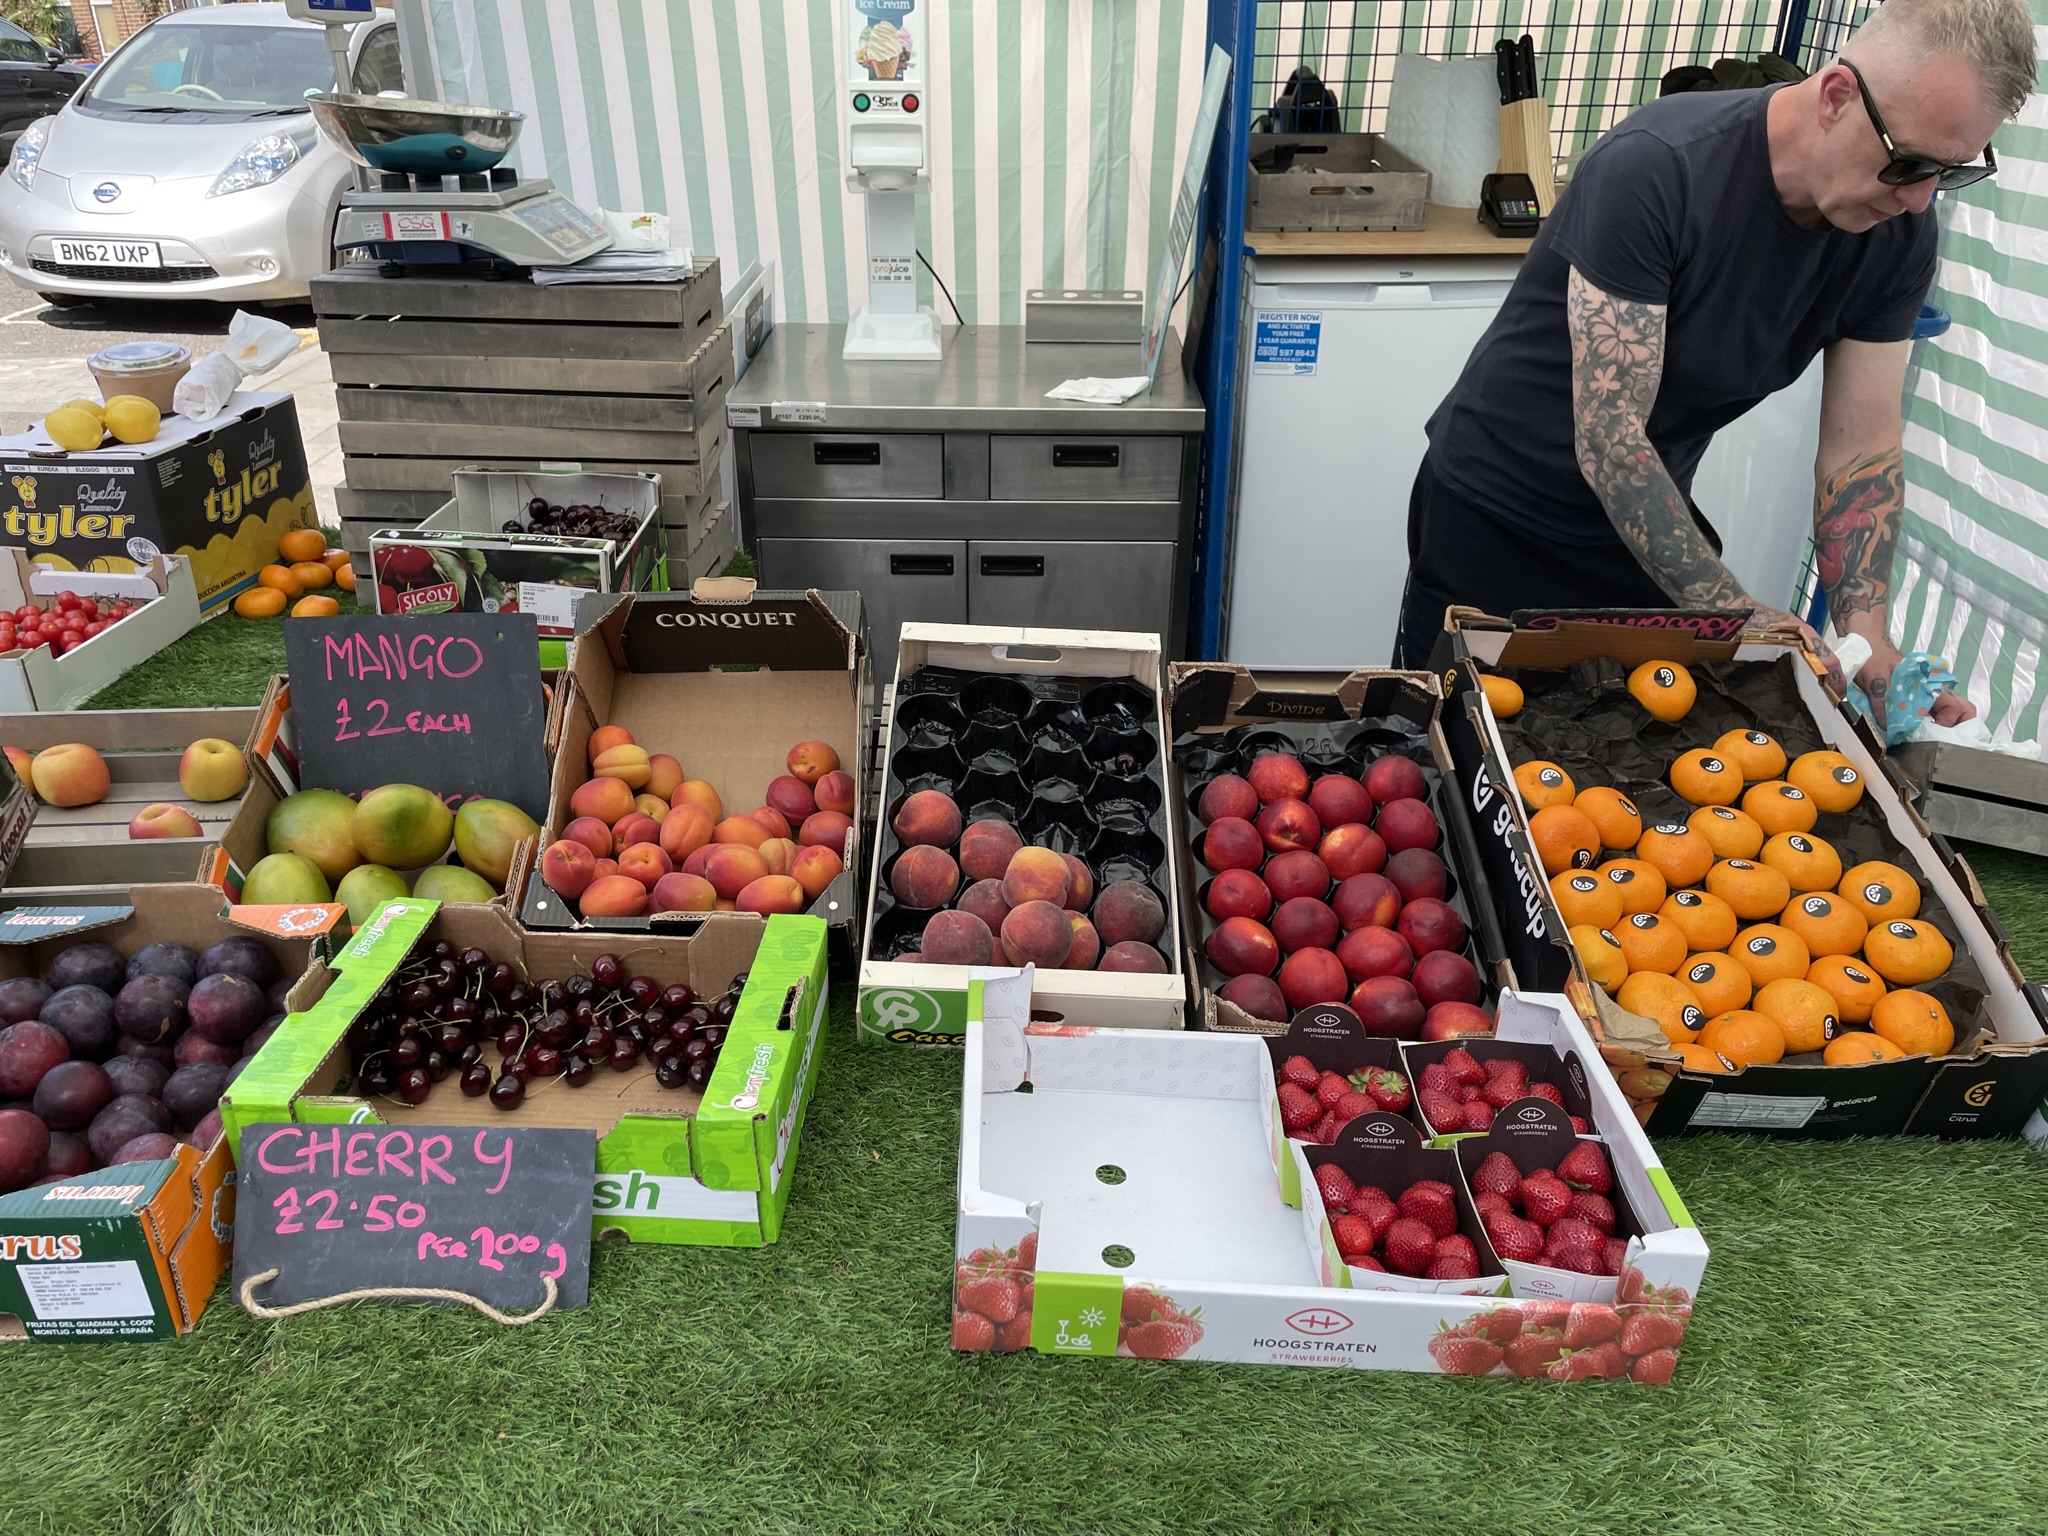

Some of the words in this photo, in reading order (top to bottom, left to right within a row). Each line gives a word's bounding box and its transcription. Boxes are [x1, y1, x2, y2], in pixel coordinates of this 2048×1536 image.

[876, 0, 911, 9] Cream
[877, 99, 899, 107] Shot
[398, 217, 434, 229] CSG
[60, 243, 110, 261] BN62
[113, 245, 149, 262] UXP
[874, 263, 909, 274] projuice
[1260, 313, 1299, 321] REGISTER
[1279, 349, 1294, 357] 597
[248, 427, 276, 462] Quality
[77, 477, 127, 512] Quality
[203, 460, 283, 524] tyler
[3, 504, 136, 546] tyler
[220, 570, 247, 589] ARGENTINA
[403, 586, 453, 611] SICOLY
[655, 612, 796, 629] CONQUET
[325, 632, 484, 682] MANGO
[1266, 700, 1326, 715] Divine
[334, 698, 406, 742] £2
[405, 711, 471, 735] EACH
[1303, 1027, 1350, 1035] HOOGSTRATEN
[1832, 1095, 1878, 1108] goldcup
[1948, 1115, 1978, 1123] Citrus
[1506, 1123, 1558, 1131] HOOGSTRATEN
[1353, 1136, 1406, 1145] HOOGSTRATEN
[257, 1126, 514, 1196] CHERRY
[0, 1235, 82, 1260] rus
[1520, 1286, 1563, 1298] HOOGSTRATEN
[76, 1320, 120, 1328] GUADIANA
[129, 1319, 156, 1327] COOP.
[120, 1326, 154, 1334] ESPAÑA
[1253, 1338, 1377, 1354] HOOGSTRATEN
[1271, 1353, 1354, 1364] STRAWBERRIES
